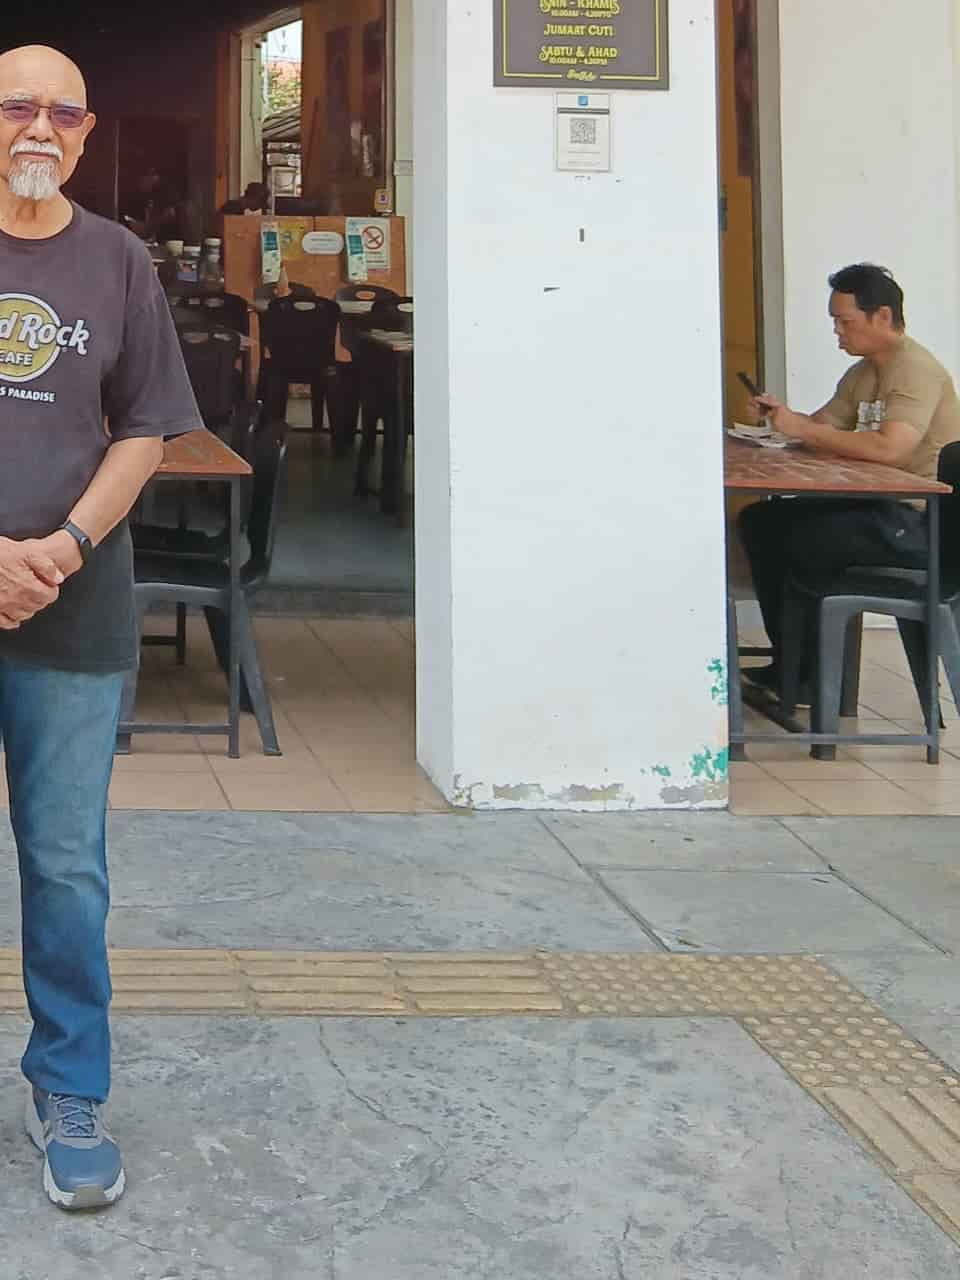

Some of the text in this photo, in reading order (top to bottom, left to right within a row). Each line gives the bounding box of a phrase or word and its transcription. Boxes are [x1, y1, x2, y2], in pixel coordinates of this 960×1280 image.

[543, 23, 614, 37] JUMAAT CUTI
[538, 46, 618, 61] SABTU & AHAD
[18, 312, 91, 355] Rock
[7, 387, 56, 403] PARADISE
